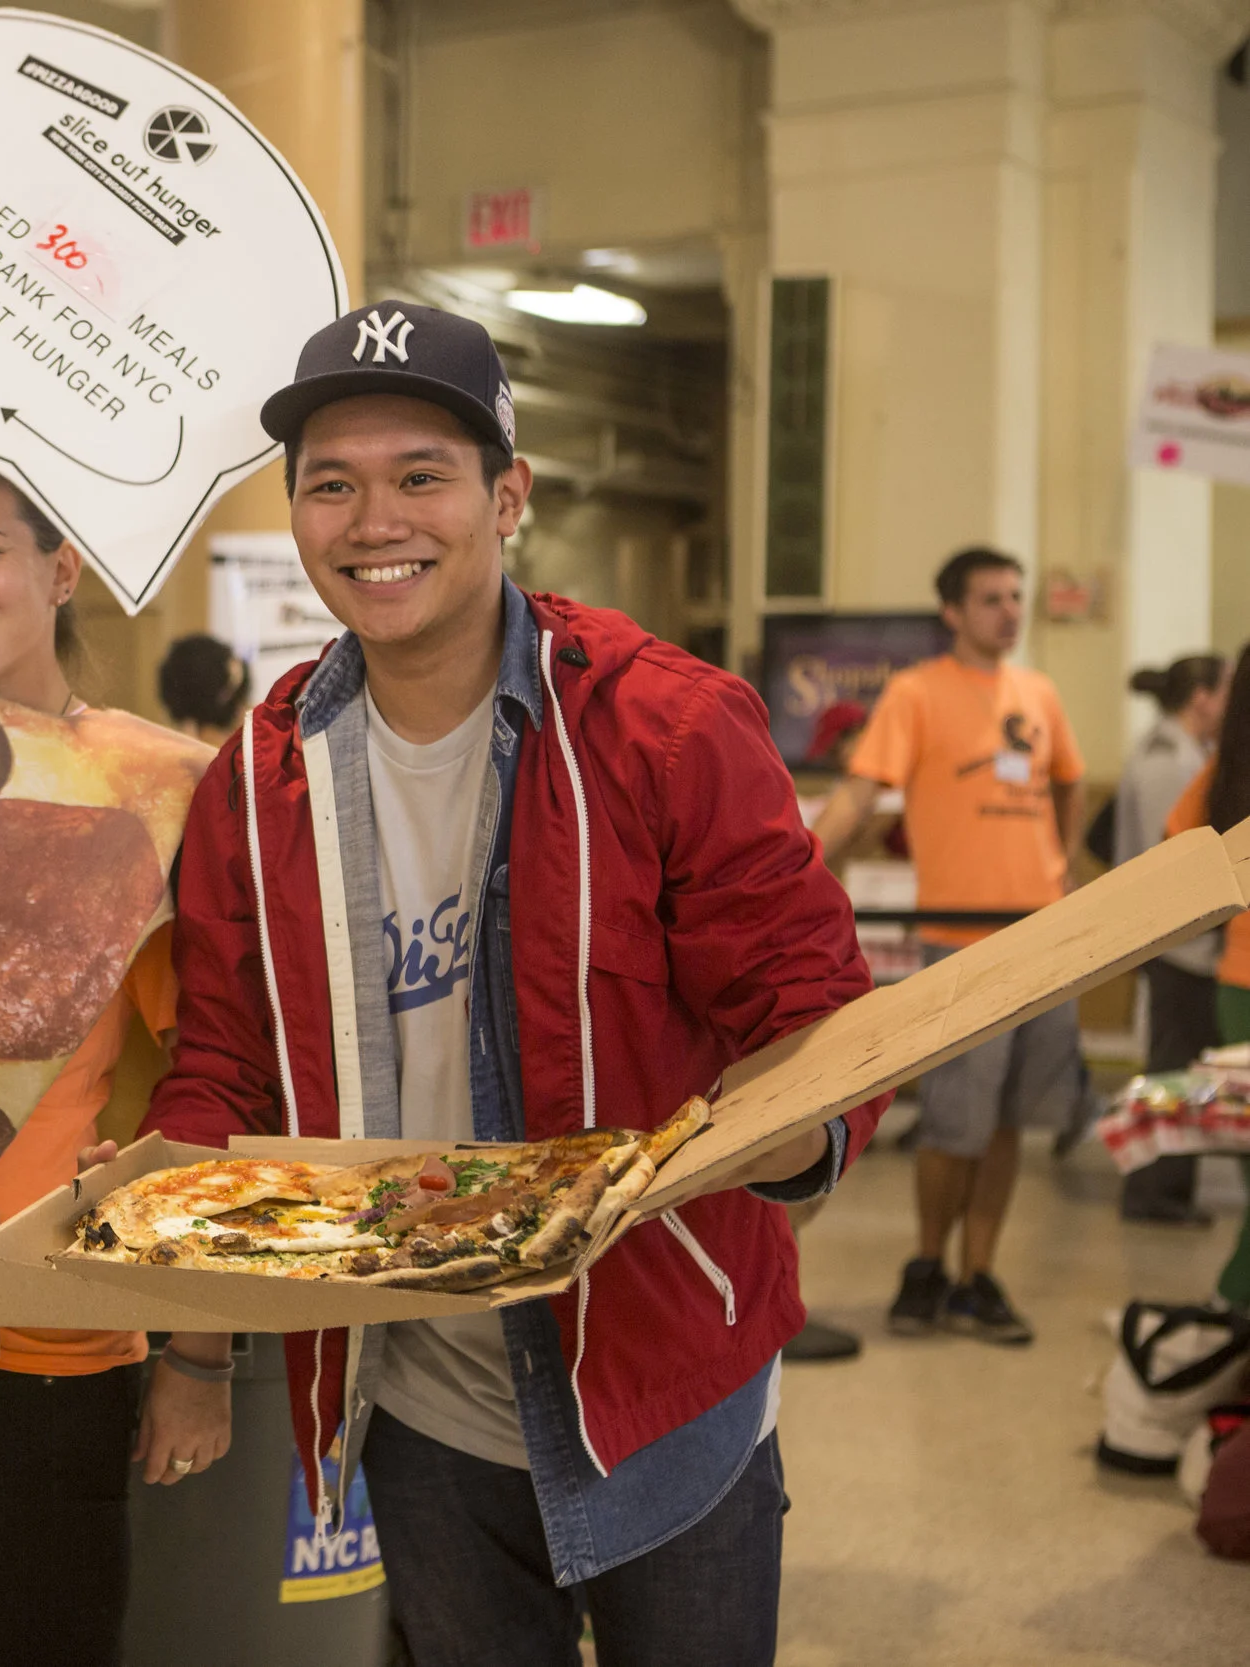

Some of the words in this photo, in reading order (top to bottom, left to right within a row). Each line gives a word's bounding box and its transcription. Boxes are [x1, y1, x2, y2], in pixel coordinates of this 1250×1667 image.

[58, 111, 109, 154] slice
[110, 153, 150, 183] out
[145, 176, 222, 239] hunger
[35, 223, 89, 270] 300
[130, 198, 156, 221] PIZZA
[151, 215, 178, 240] PARTY
[52, 305, 112, 357] FOR
[112, 353, 172, 404] NYC
[127, 313, 220, 391] MEALS
[351, 310, 415, 363] NY
[12, 325, 126, 421] HUNGER
[292, 1530, 358, 1573] NYC
